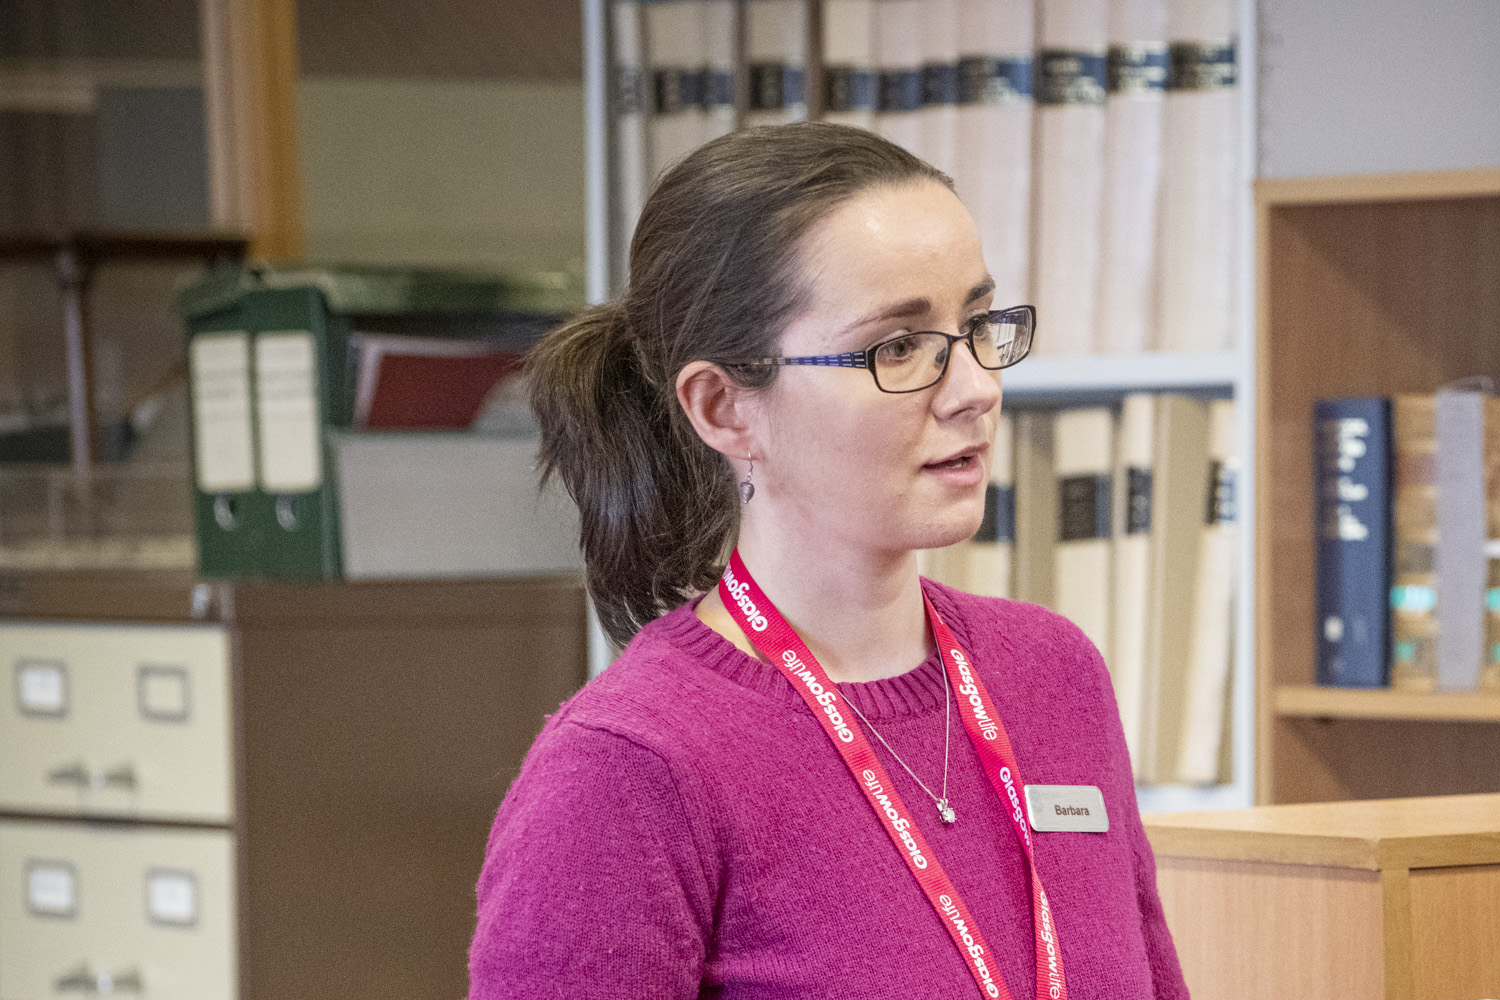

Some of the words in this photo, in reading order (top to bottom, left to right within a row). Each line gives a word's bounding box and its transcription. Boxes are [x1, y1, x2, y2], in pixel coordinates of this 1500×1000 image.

[722, 563, 768, 632] Glasgow
[782, 649, 854, 743] Glasgowlife
[950, 649, 998, 741] Glasgowlife
[862, 769, 928, 870] Glasgowlife
[999, 766, 1030, 846] Glasgow
[1054, 804, 1090, 816] Barbara
[939, 894, 999, 998] Glasgowlife
[1040, 890, 1063, 1000] Glasgowlife
